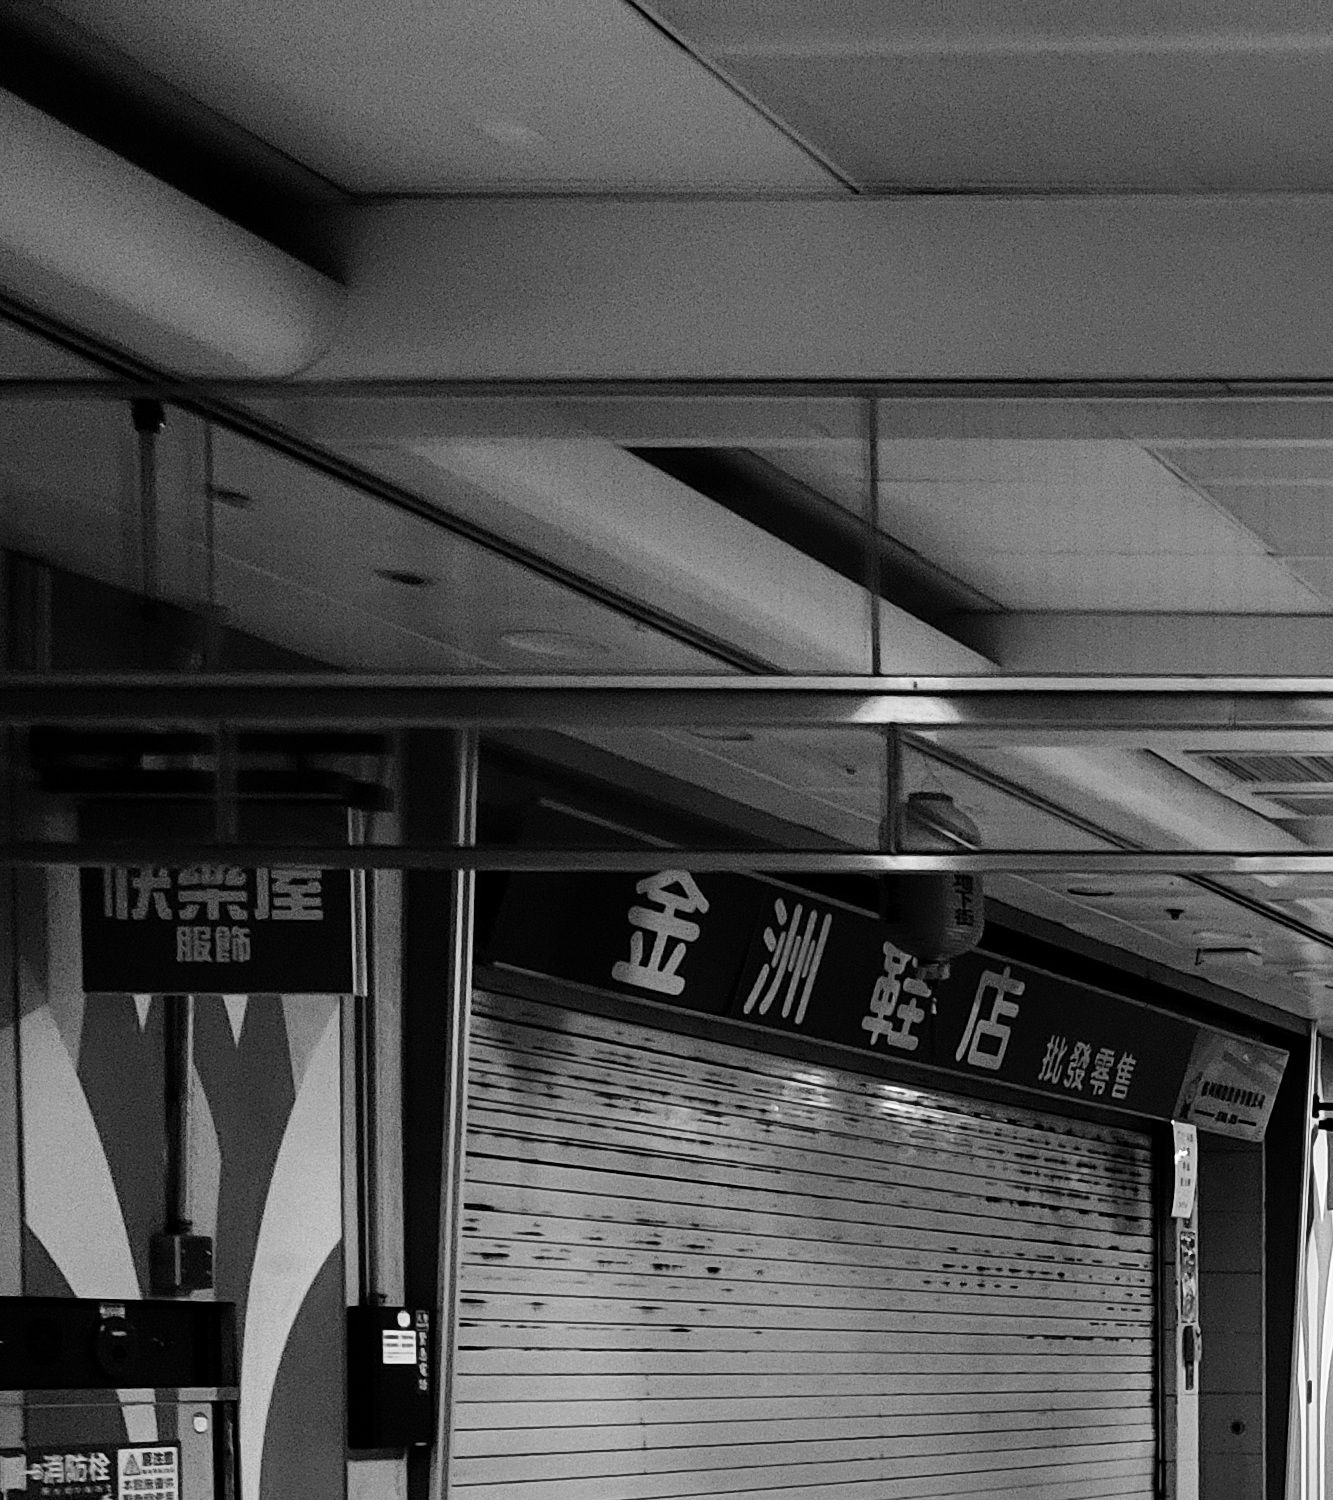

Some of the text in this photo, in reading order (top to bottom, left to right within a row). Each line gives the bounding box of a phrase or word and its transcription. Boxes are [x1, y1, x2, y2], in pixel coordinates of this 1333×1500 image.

[176, 926, 251, 963] 服飾
[1037, 1034, 1138, 1100] 批發零售
[43, 1452, 111, 1484] 消防栓
